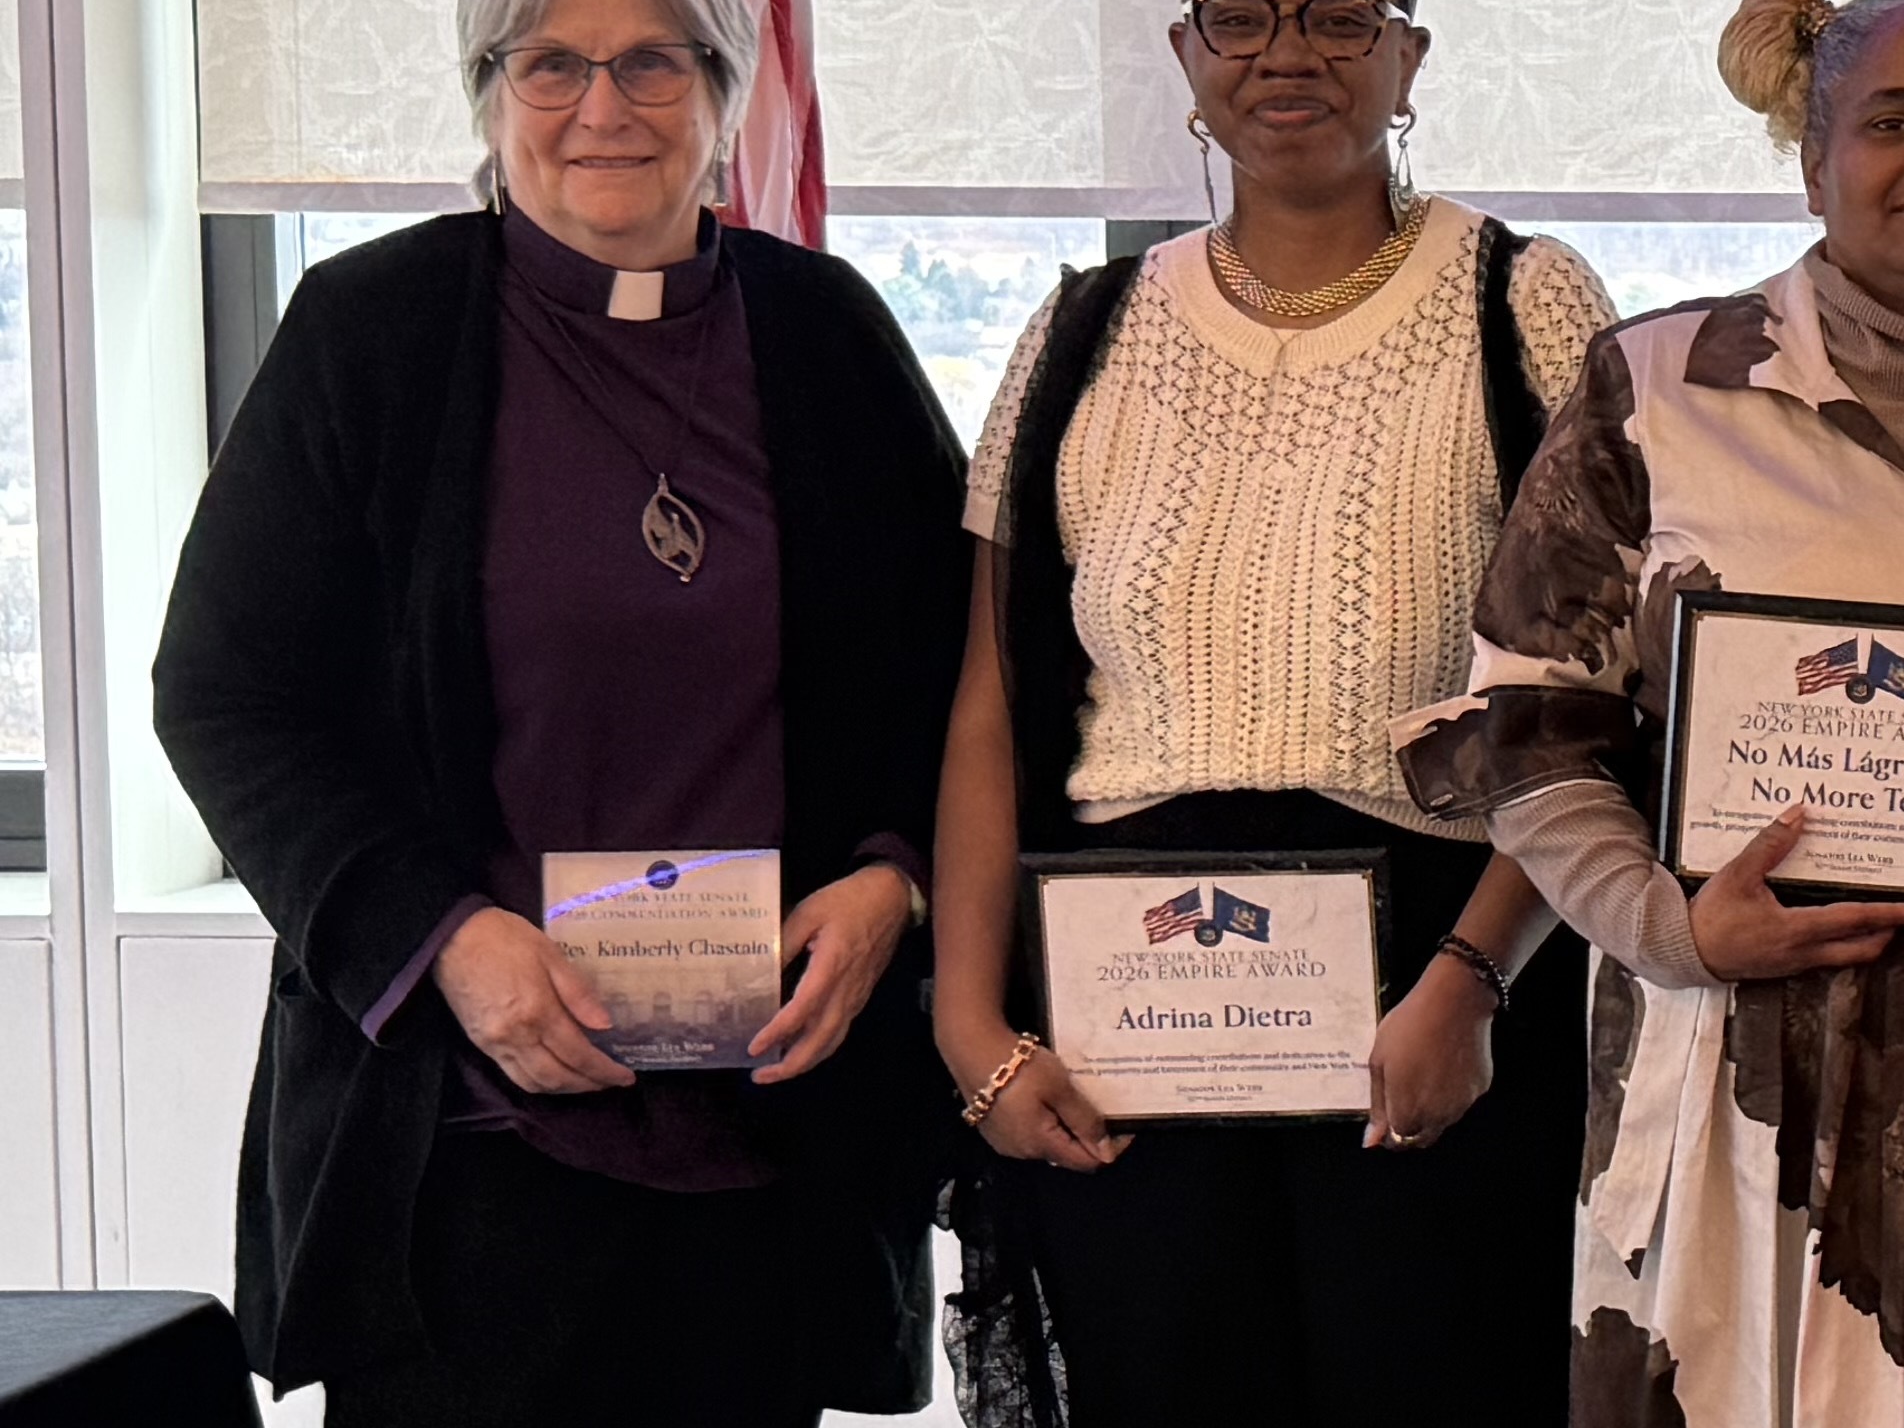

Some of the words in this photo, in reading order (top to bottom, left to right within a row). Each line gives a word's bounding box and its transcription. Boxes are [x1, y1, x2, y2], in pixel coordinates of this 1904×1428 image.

[1800, 703, 1843, 718] YORK
[1739, 714, 1793, 733] 2026
[1802, 721, 1883, 740] EMPIRE
[1728, 740, 1768, 765] No
[1777, 743, 1833, 771] Más
[1751, 777, 1791, 803] No
[1801, 782, 1875, 810] More
[598, 940, 682, 961] Kimberly
[689, 939, 769, 958] Chastain
[1098, 966, 1149, 981] 2026
[1159, 964, 1237, 980] EMPIRE
[1247, 961, 1326, 978] AWARD
[1116, 1005, 1213, 1030] Adrina
[1224, 1004, 1312, 1028] Dietra
